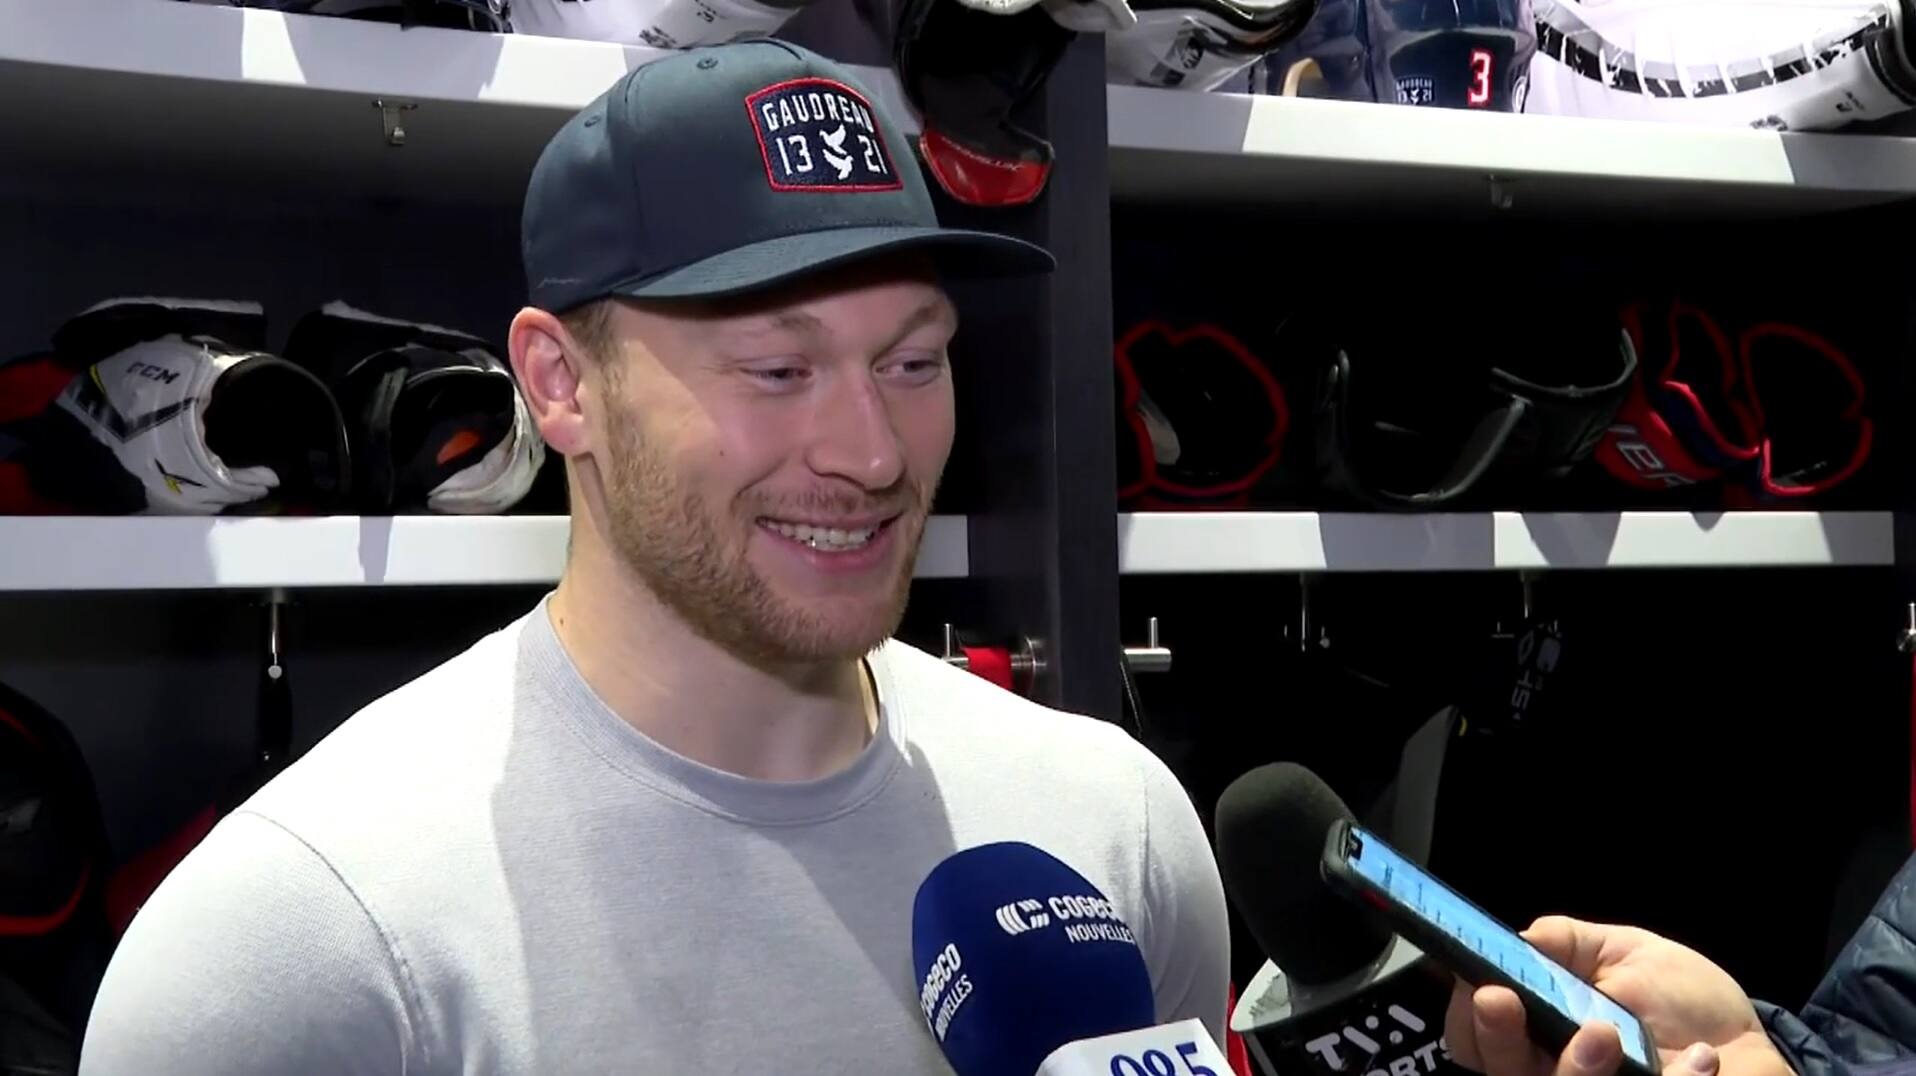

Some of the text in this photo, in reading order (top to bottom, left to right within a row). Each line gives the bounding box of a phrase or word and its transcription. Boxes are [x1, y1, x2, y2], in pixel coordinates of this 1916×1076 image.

[1468, 49, 1493, 105] 3
[762, 92, 874, 133] GAUDREAU
[776, 134, 888, 176] 13 21
[126, 361, 181, 384] CCM
